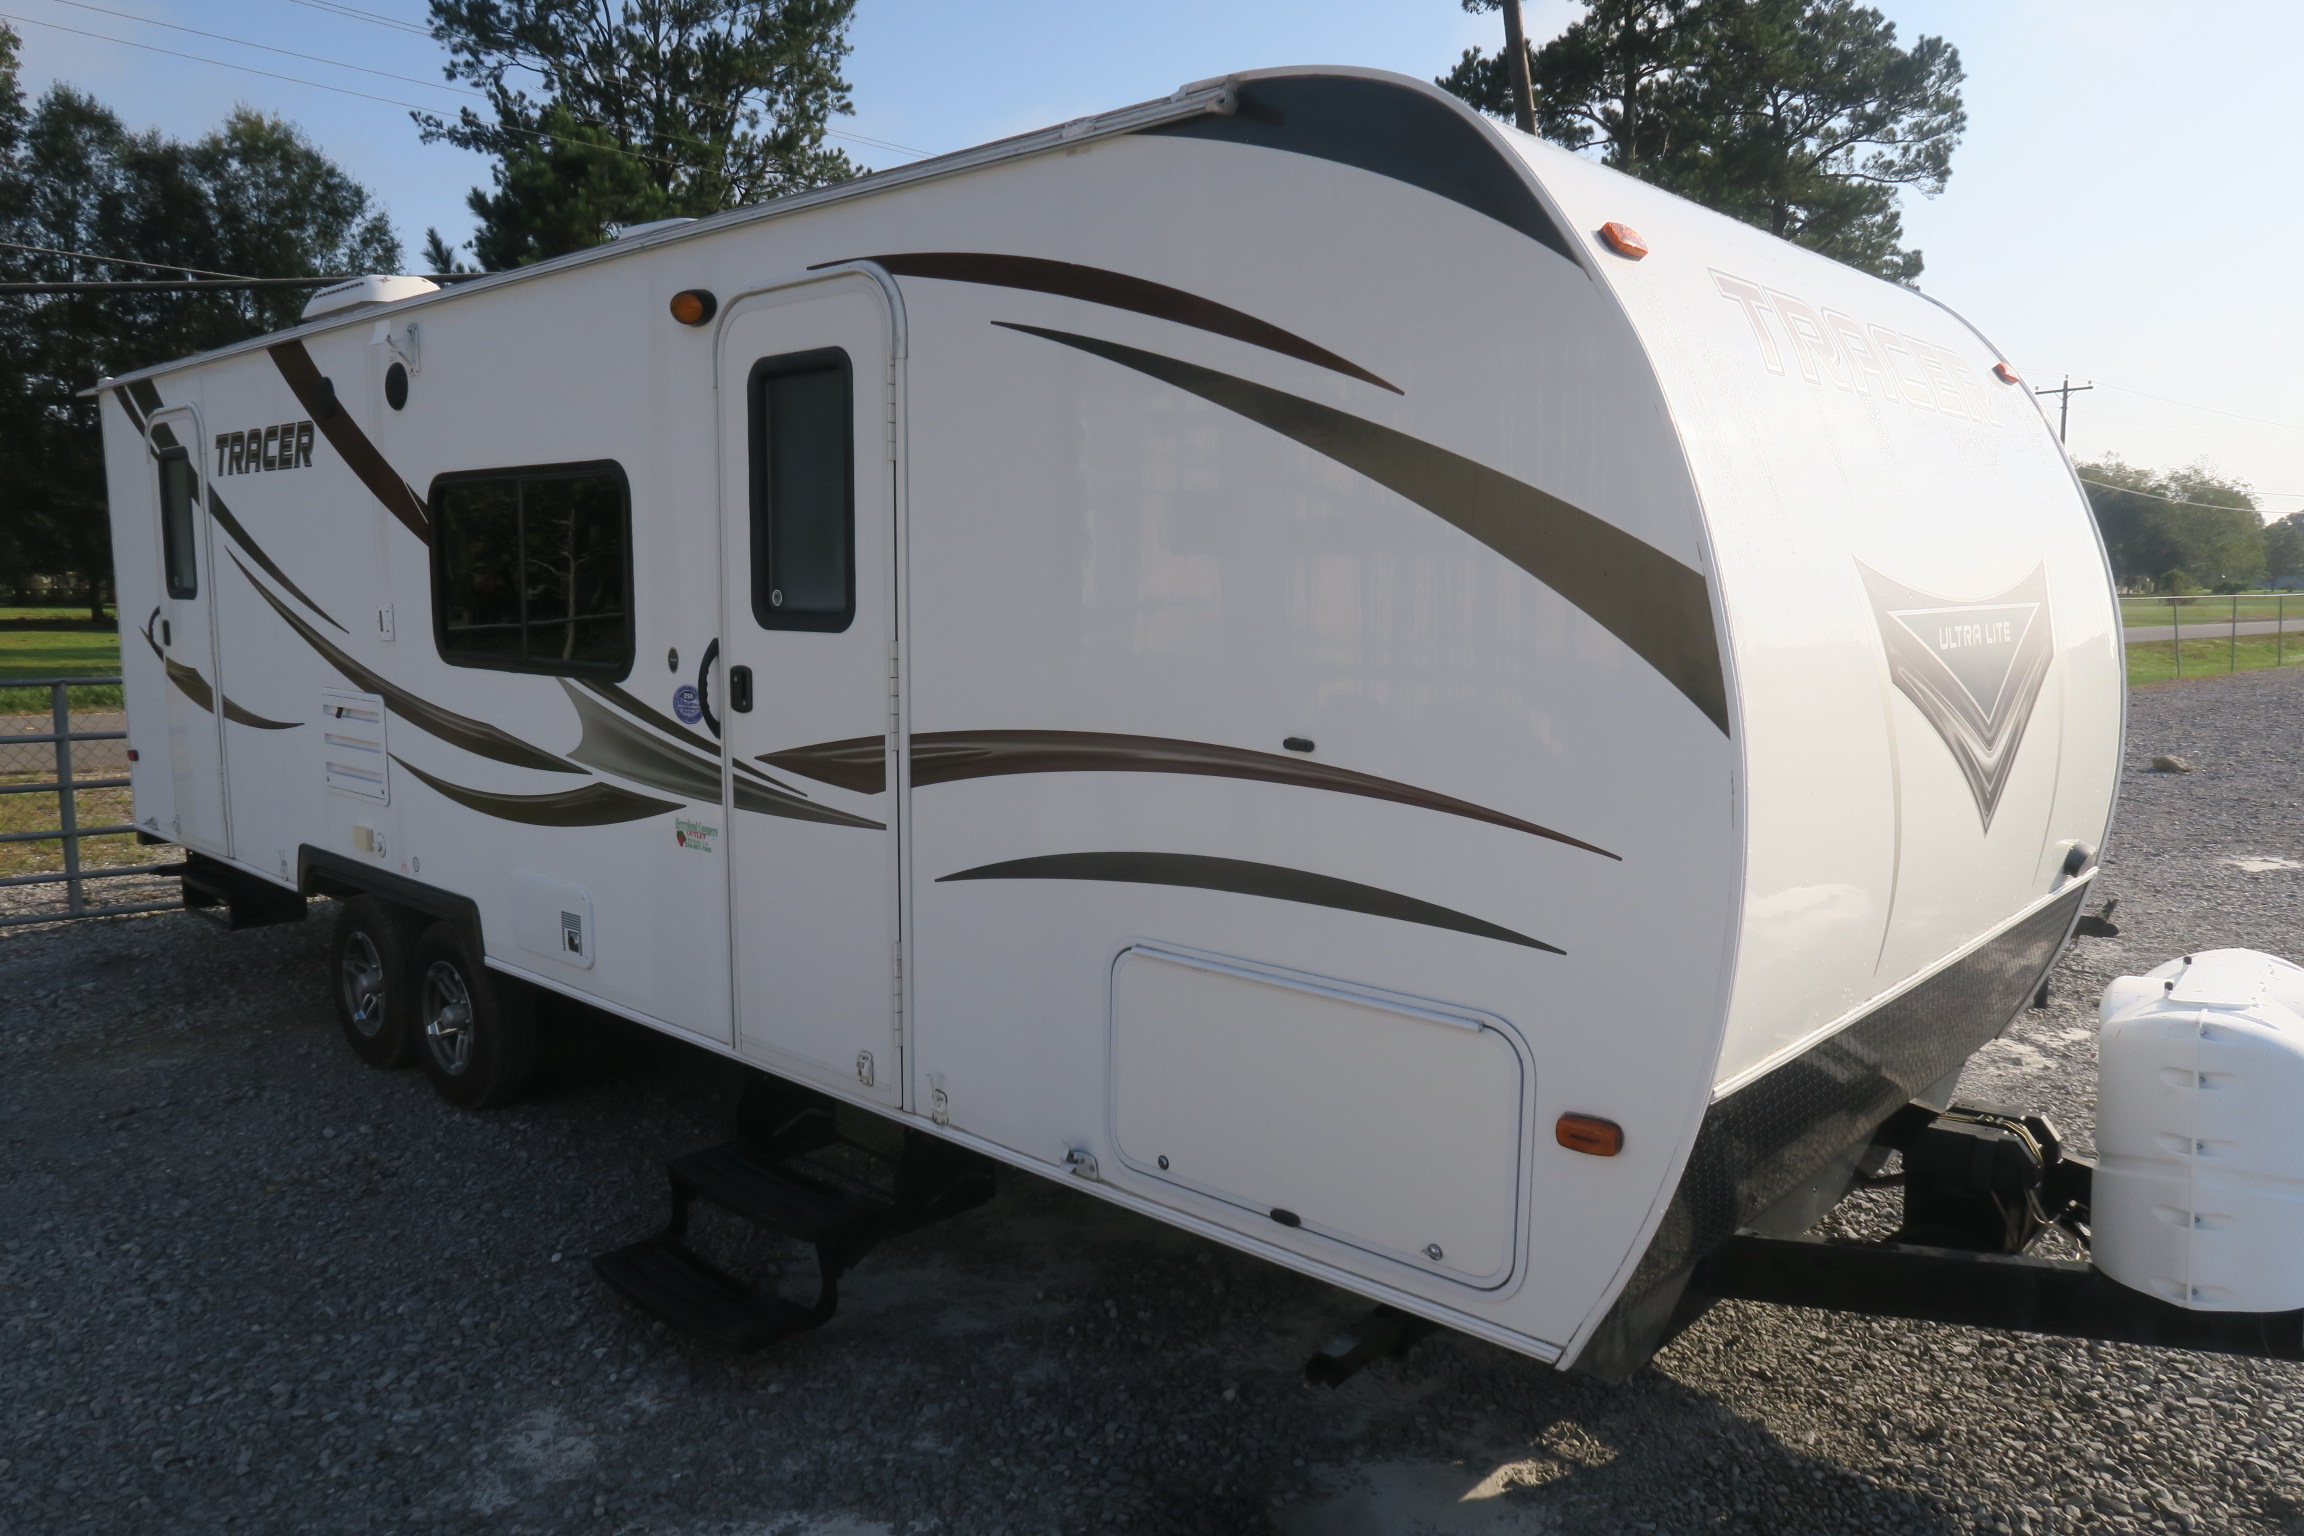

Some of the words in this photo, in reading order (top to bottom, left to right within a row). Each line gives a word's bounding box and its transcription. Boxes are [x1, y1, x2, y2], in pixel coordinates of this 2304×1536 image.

[1706, 266, 2003, 429] TRACER
[215, 420, 315, 476] TRACER
[1939, 624, 1982, 650] ULTRA
[1985, 621, 2011, 644] LITE
[687, 830, 706, 839] OUTLET
